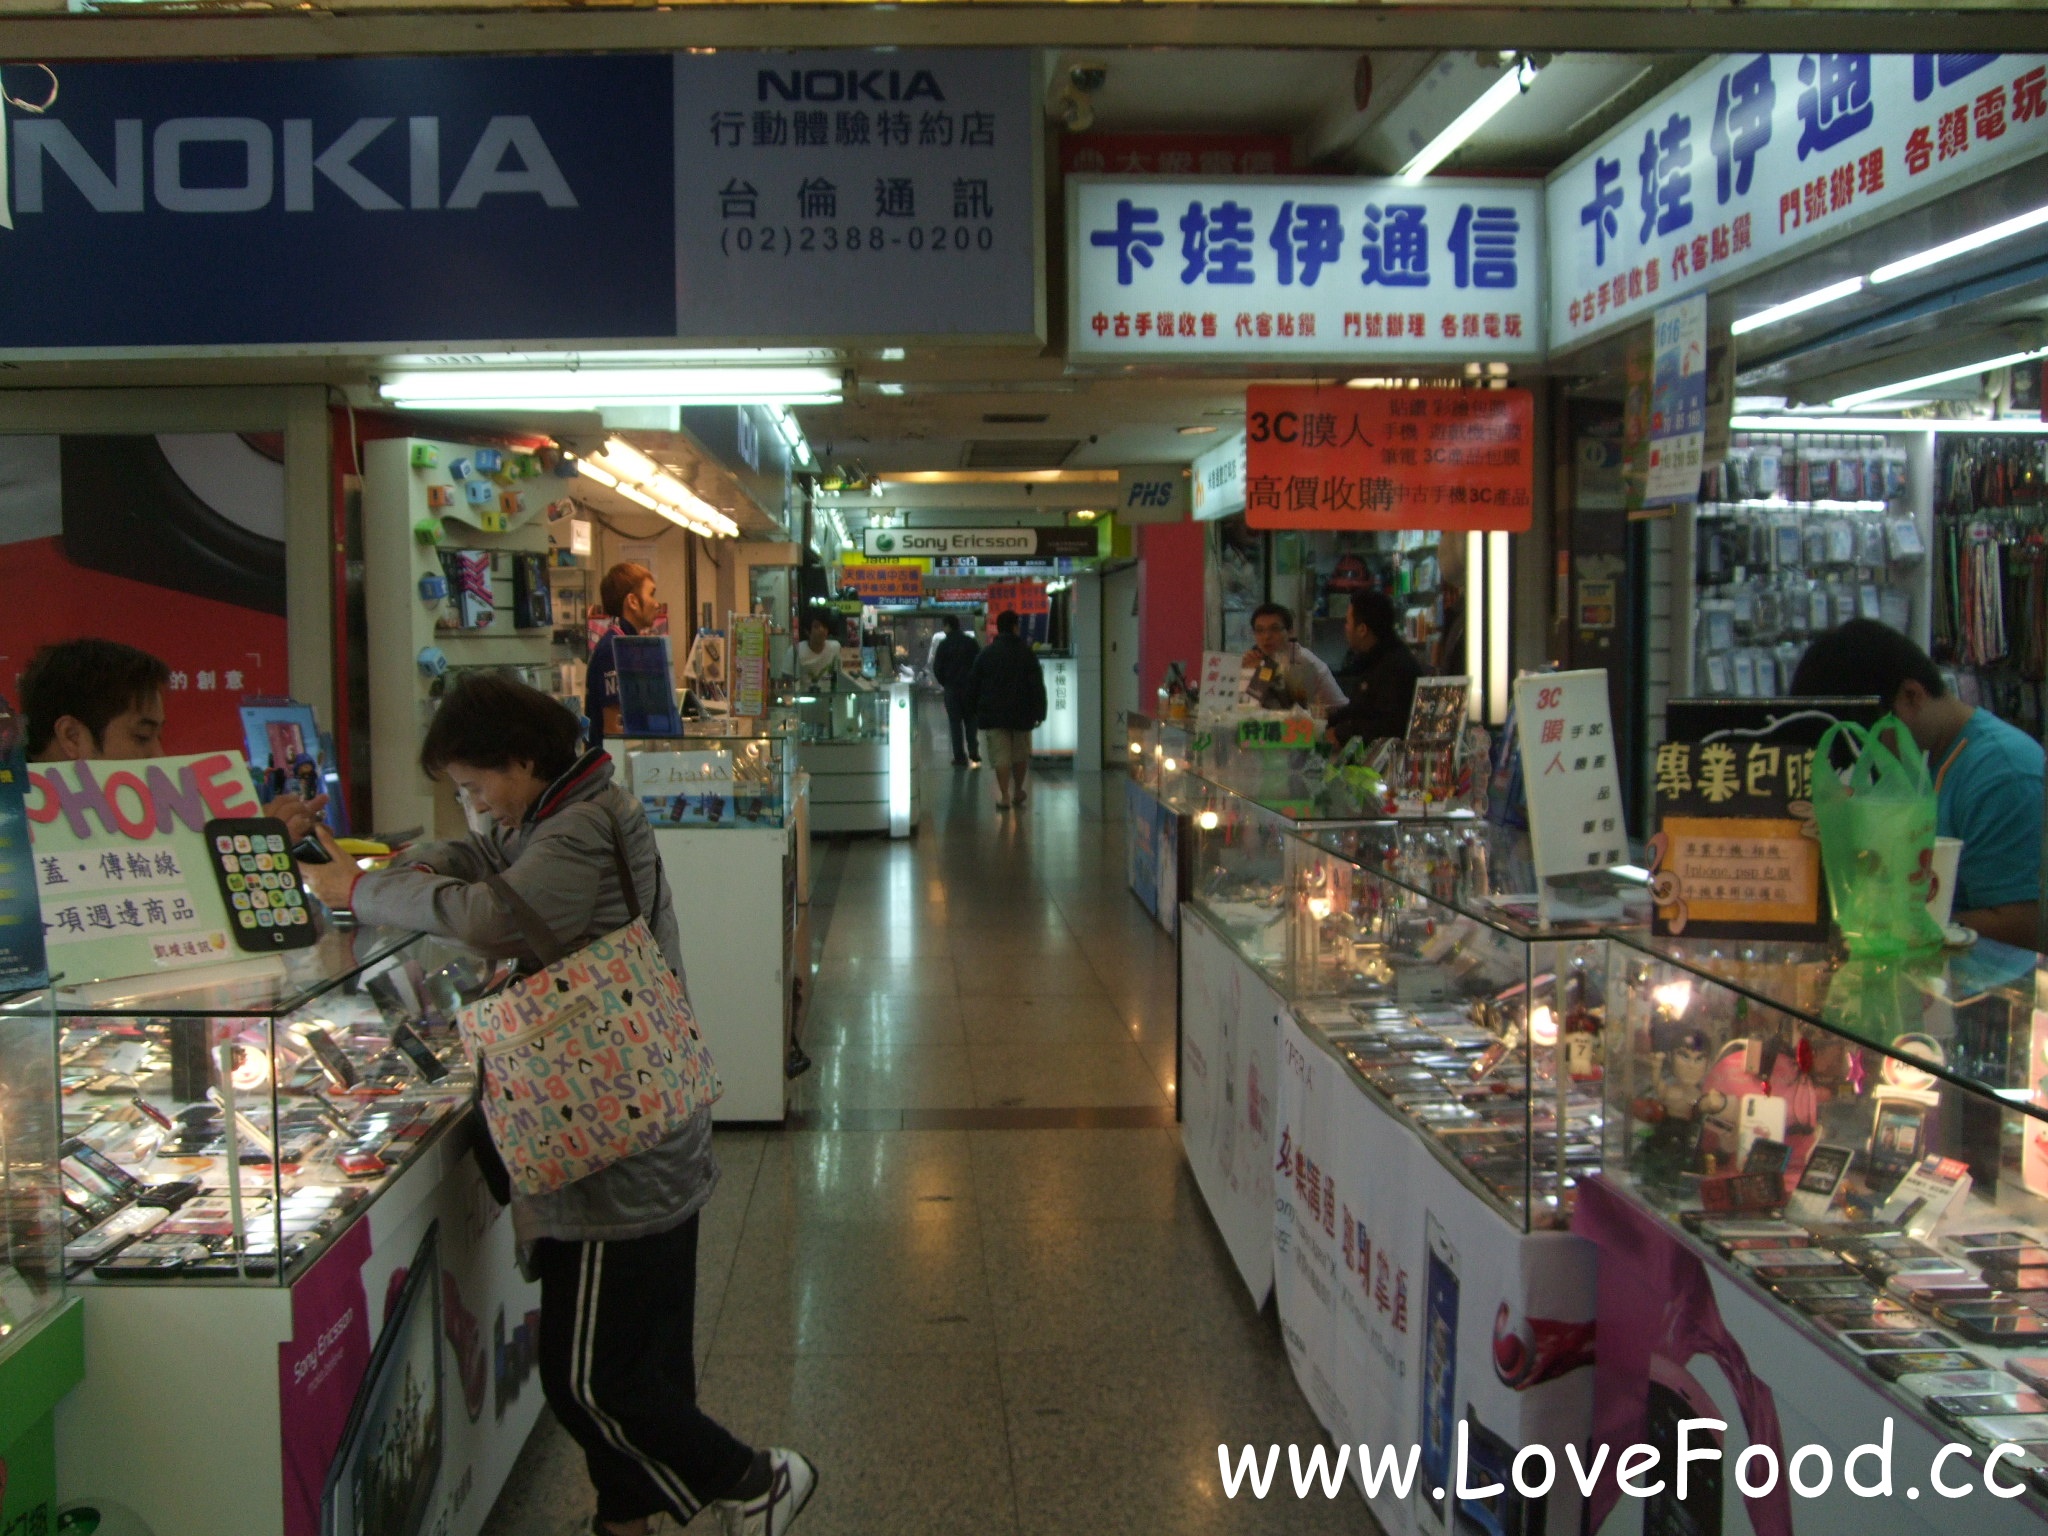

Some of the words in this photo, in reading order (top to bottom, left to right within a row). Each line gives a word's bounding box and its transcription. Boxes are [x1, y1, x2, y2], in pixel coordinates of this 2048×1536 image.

[757, 69, 946, 101] NOKIA
[710, 110, 995, 147] 行動體驗特約店
[13, 115, 579, 213] NOKIA
[719, 177, 993, 219] 台倫通訊
[720, 226, 994, 256] (02)2388-0200
[1091, 198, 1521, 288] 卡娃伊通信
[1091, 312, 1218, 338] 中古手機收售
[1250, 411, 1374, 449] 3C膜人
[1128, 482, 1173, 508] PHS
[1249, 475, 1394, 511] 高價收購
[902, 535, 948, 552] Sony
[952, 534, 1028, 550] Ericsson
[42, 897, 195, 937] 項週邊商品
[294, 1350, 318, 1384] Sony
